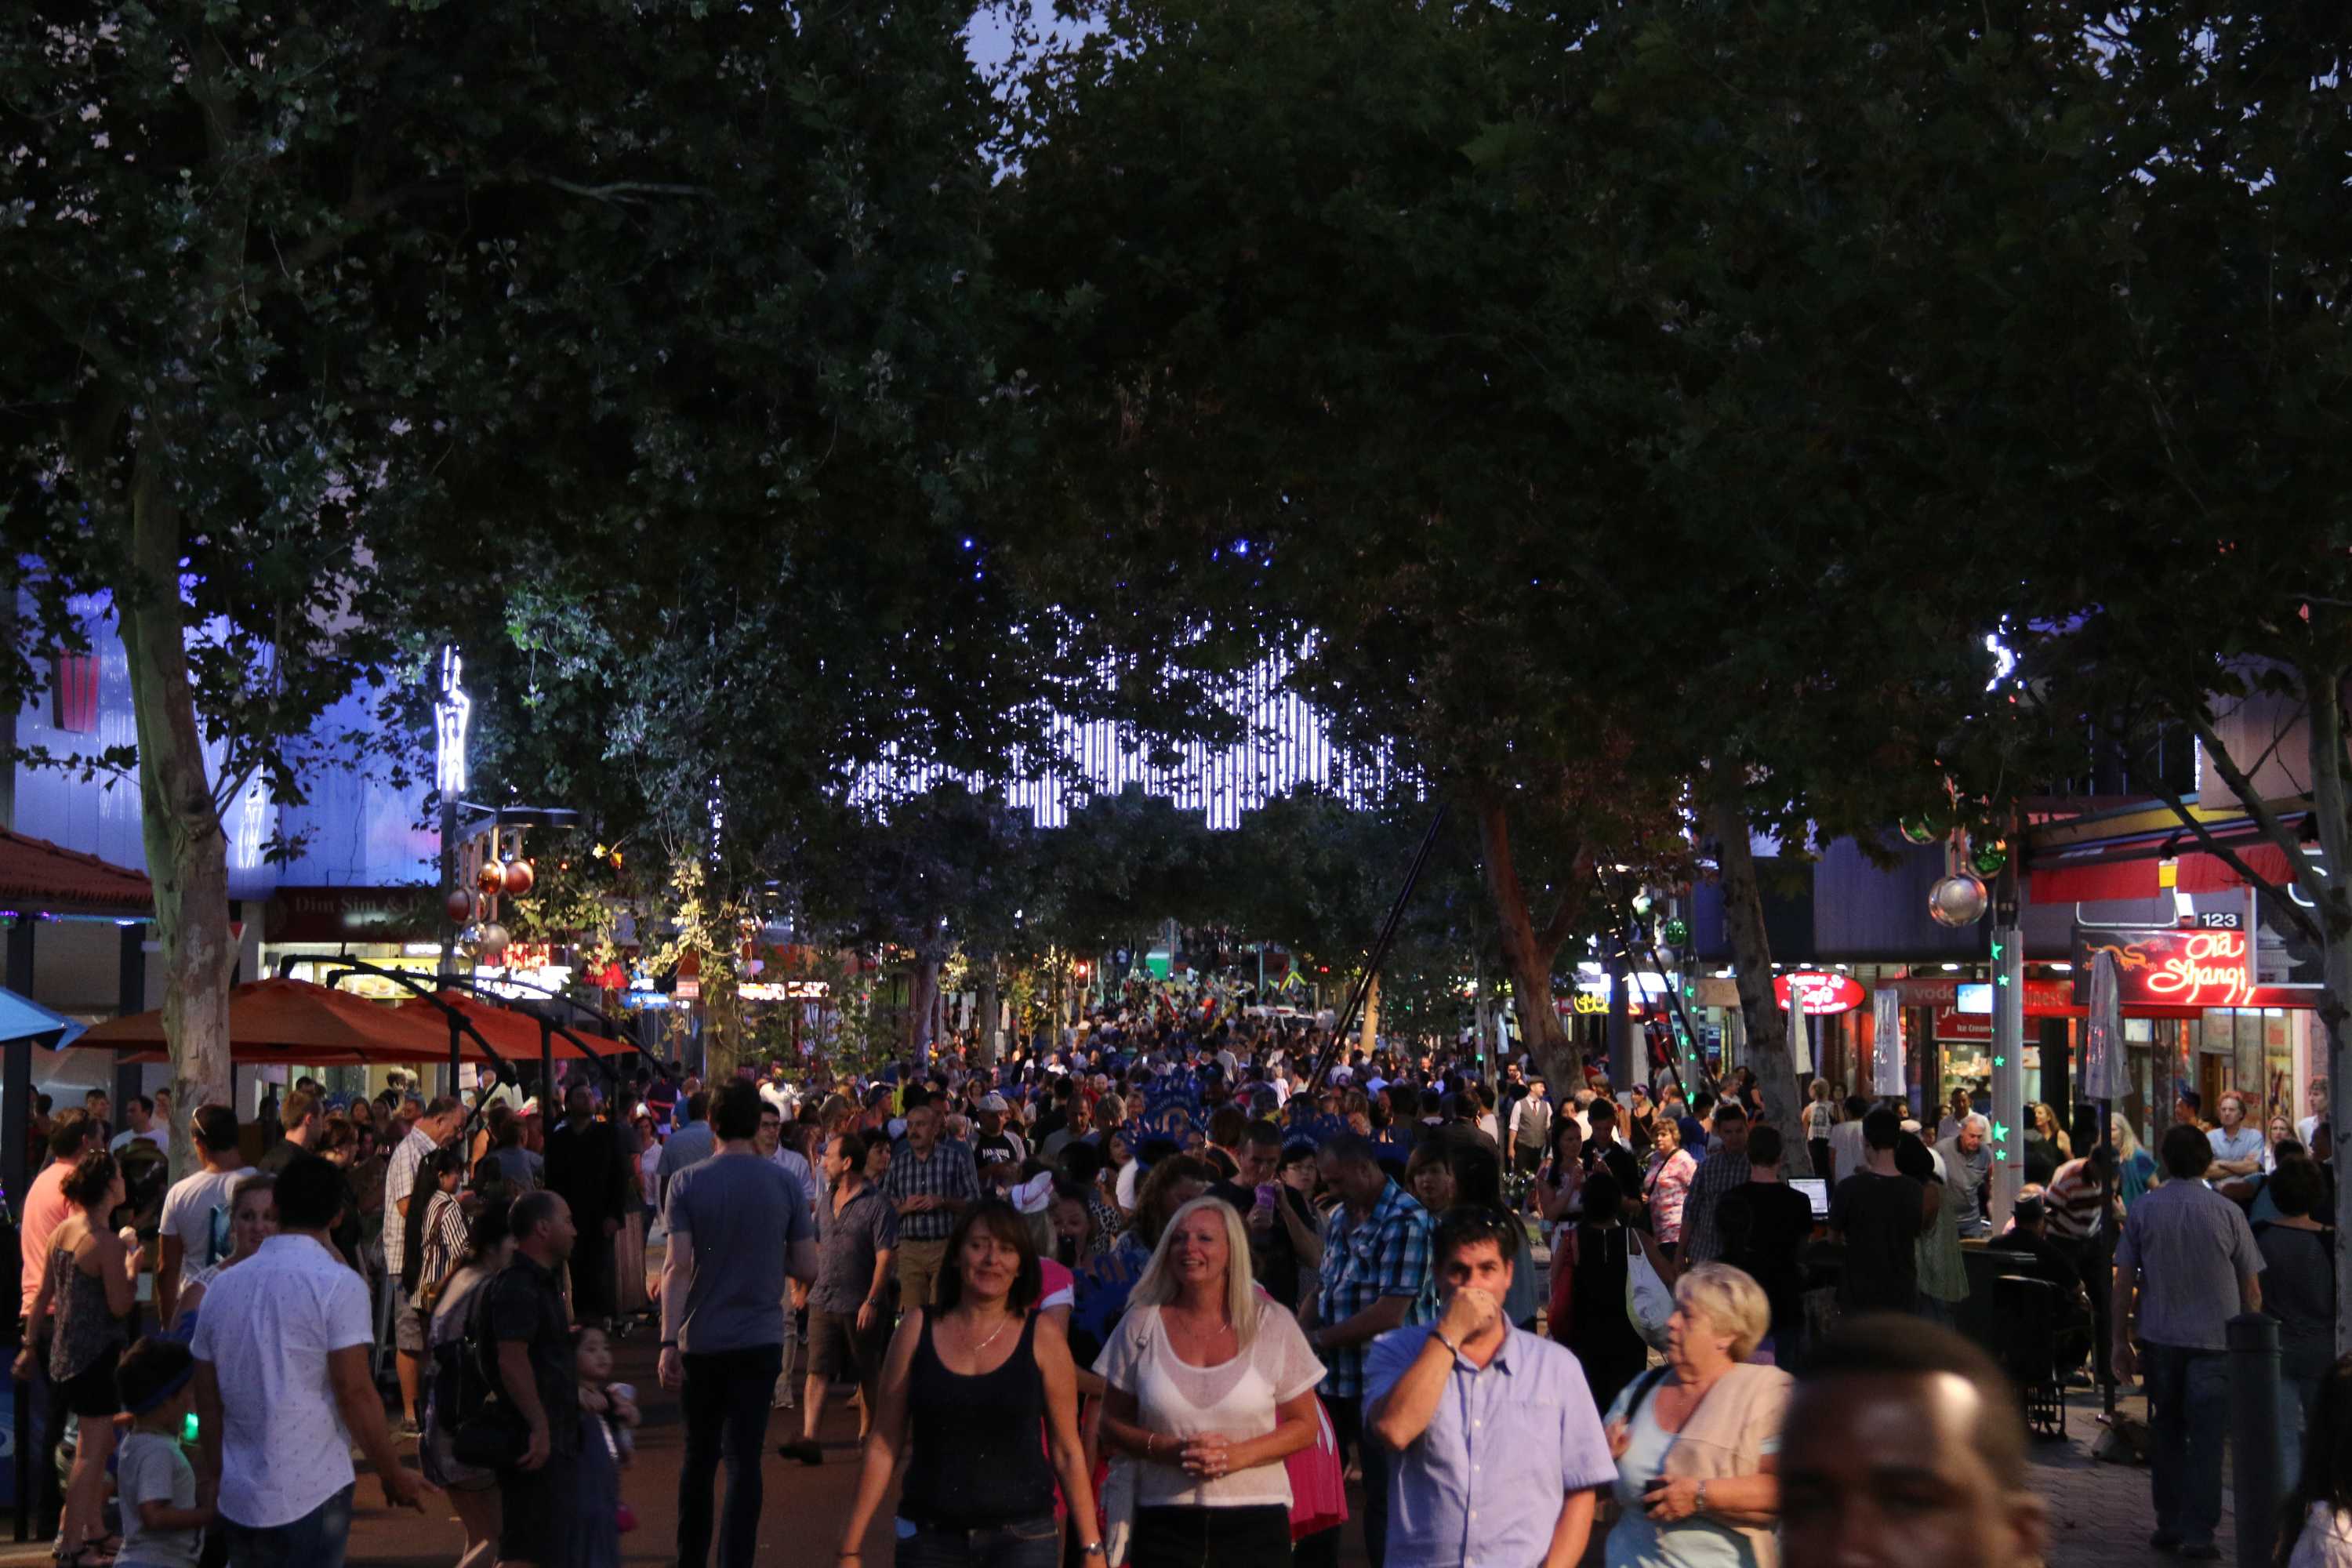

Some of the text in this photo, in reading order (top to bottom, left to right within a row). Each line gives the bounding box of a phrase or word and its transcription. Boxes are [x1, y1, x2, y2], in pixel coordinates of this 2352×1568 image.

[296, 895, 335, 913] Dim
[340, 897, 376, 912] Sim
[2202, 913, 2237, 927] 123
